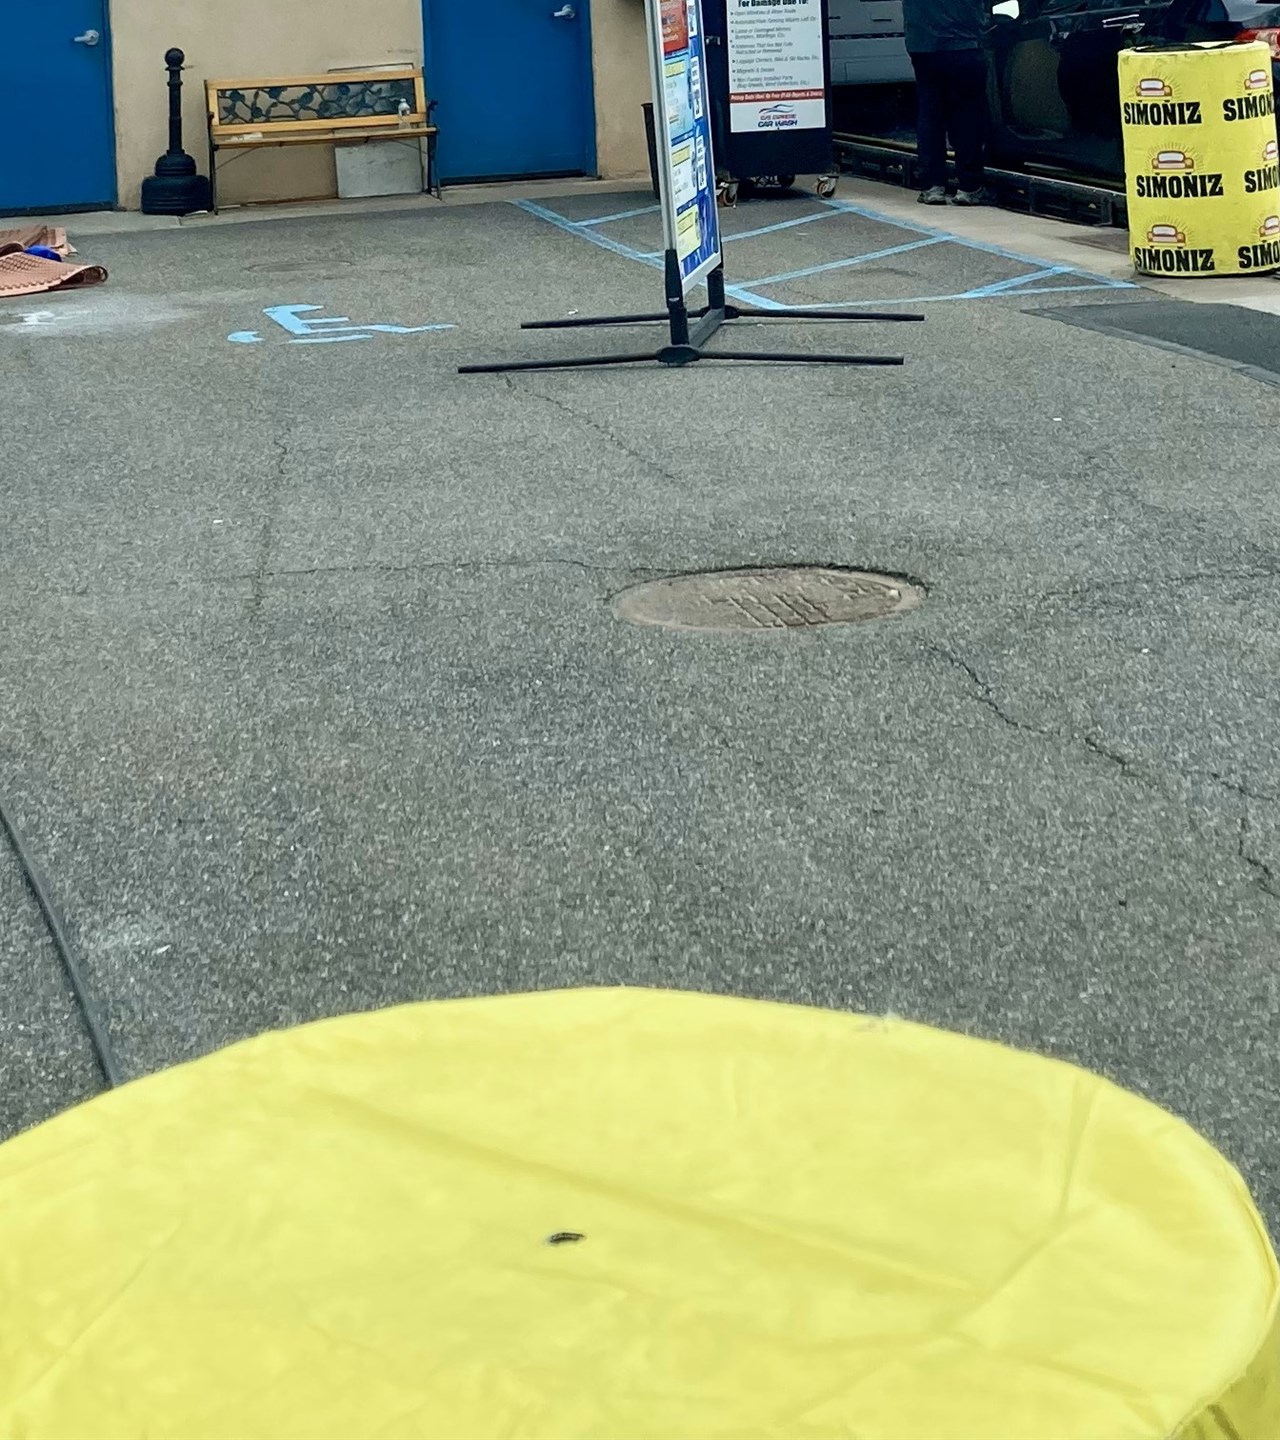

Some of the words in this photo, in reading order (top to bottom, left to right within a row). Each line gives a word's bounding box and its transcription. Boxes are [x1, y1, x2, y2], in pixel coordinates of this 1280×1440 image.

[751, 0, 781, 7] Damage
[1123, 100, 1202, 126] SIMONIZ
[1136, 172, 1224, 199] SIMONIZ
[1134, 246, 1215, 272] SIMONIZ
